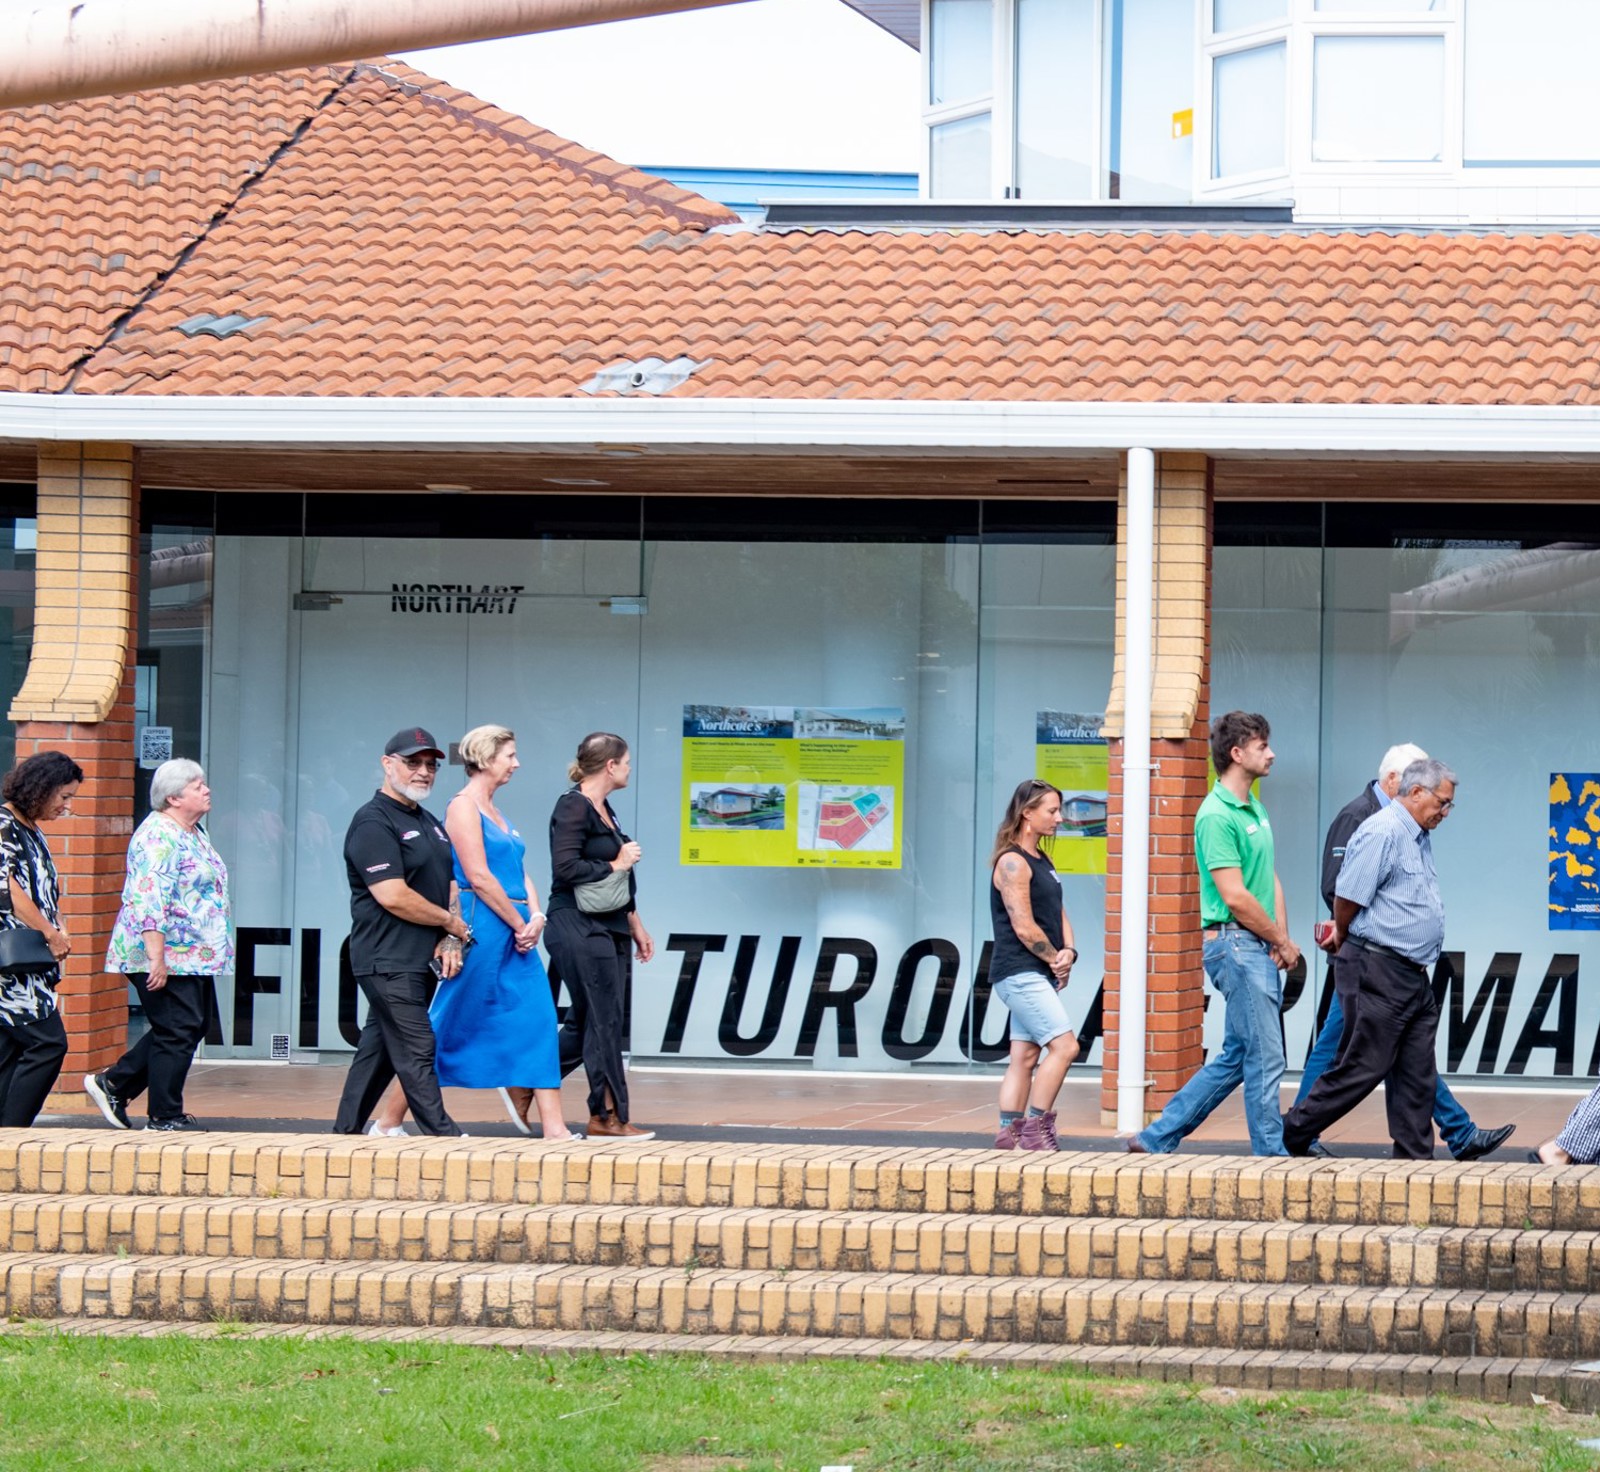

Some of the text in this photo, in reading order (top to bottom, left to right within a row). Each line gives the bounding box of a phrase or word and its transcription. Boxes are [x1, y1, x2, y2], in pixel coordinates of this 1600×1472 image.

[391, 583, 525, 614] NORTHART
[697, 719, 762, 732] Northcote's
[1051, 726, 1102, 738] Northco
[204, 927, 363, 1048] FI
